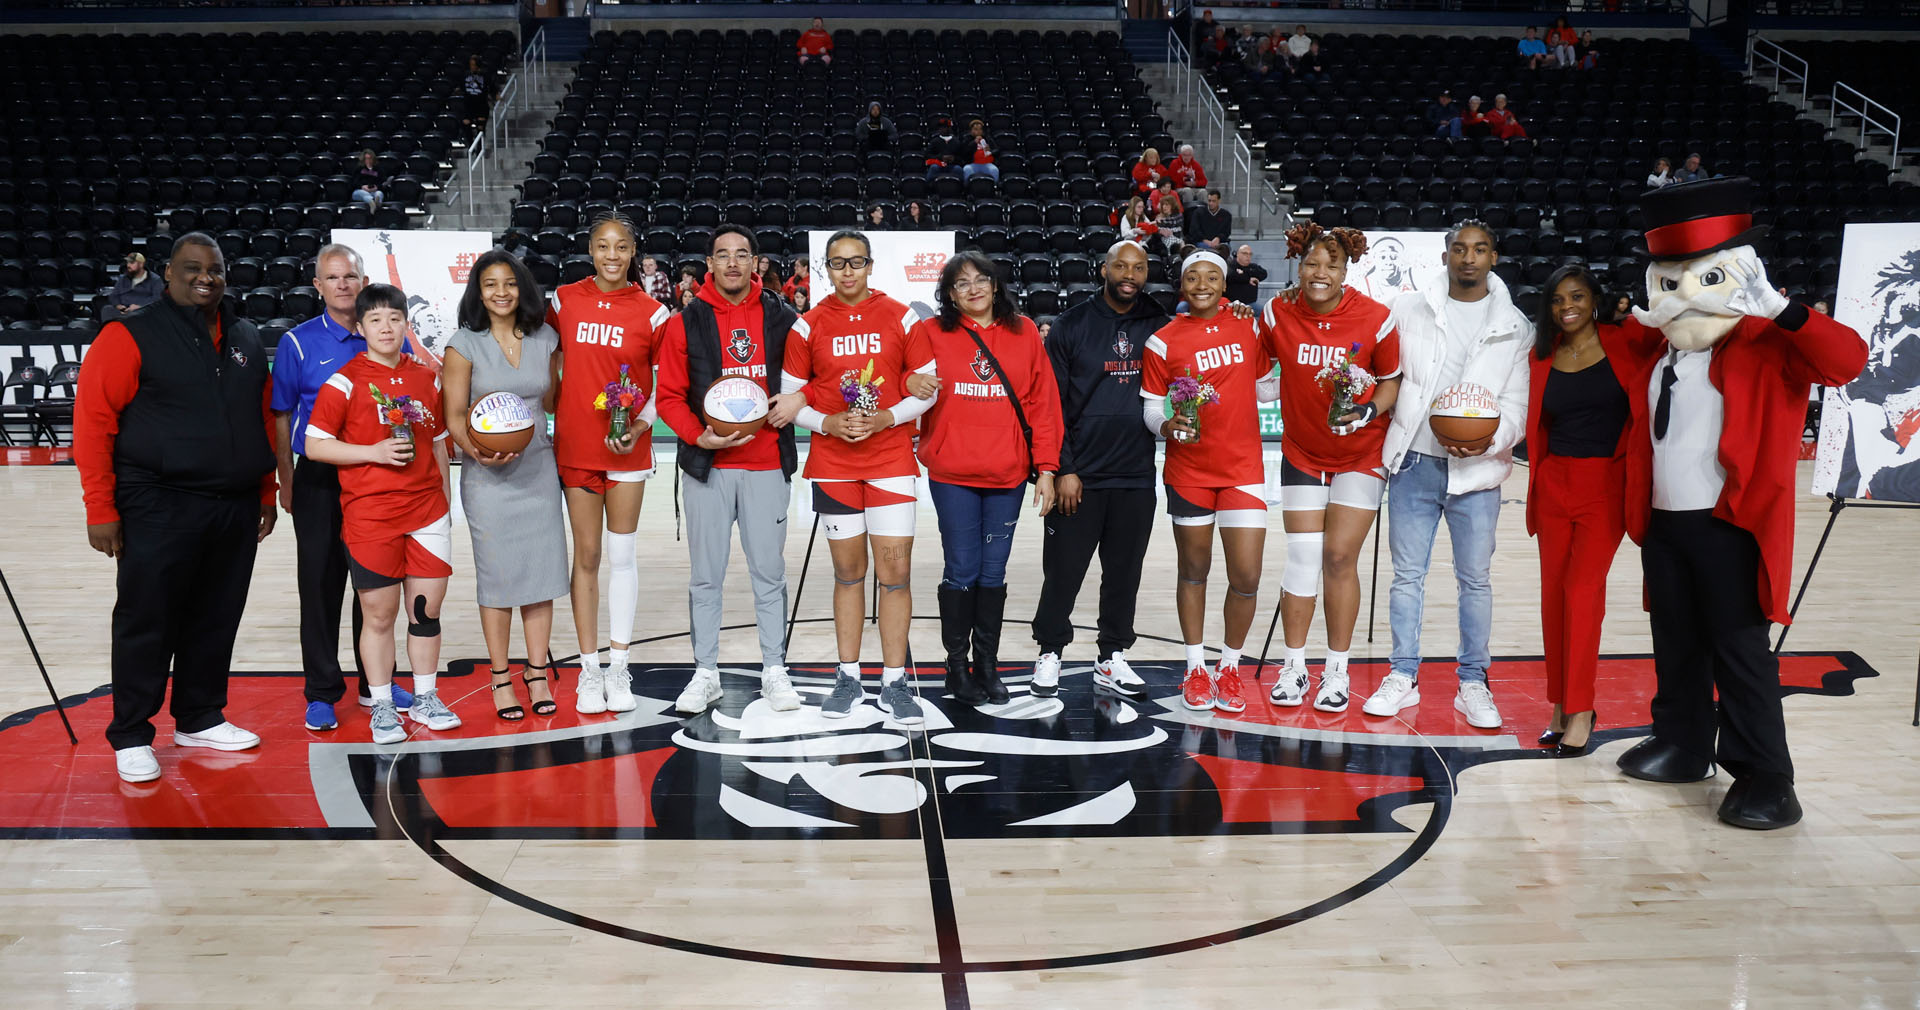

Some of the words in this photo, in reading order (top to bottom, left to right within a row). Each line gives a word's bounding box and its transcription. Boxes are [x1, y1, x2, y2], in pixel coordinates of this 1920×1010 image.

[913, 252, 947, 267] #32
[576, 321, 624, 348] GOVS
[832, 333, 881, 357] GOVS
[1194, 343, 1244, 372] GOVS
[1297, 343, 1346, 368] GOVS
[721, 366, 750, 377] USTIN
[751, 364, 767, 377] PEA
[1104, 360, 1129, 371] AUSTIN
[953, 382, 989, 397] AUSTIN
[990, 384, 1009, 397] PEA
